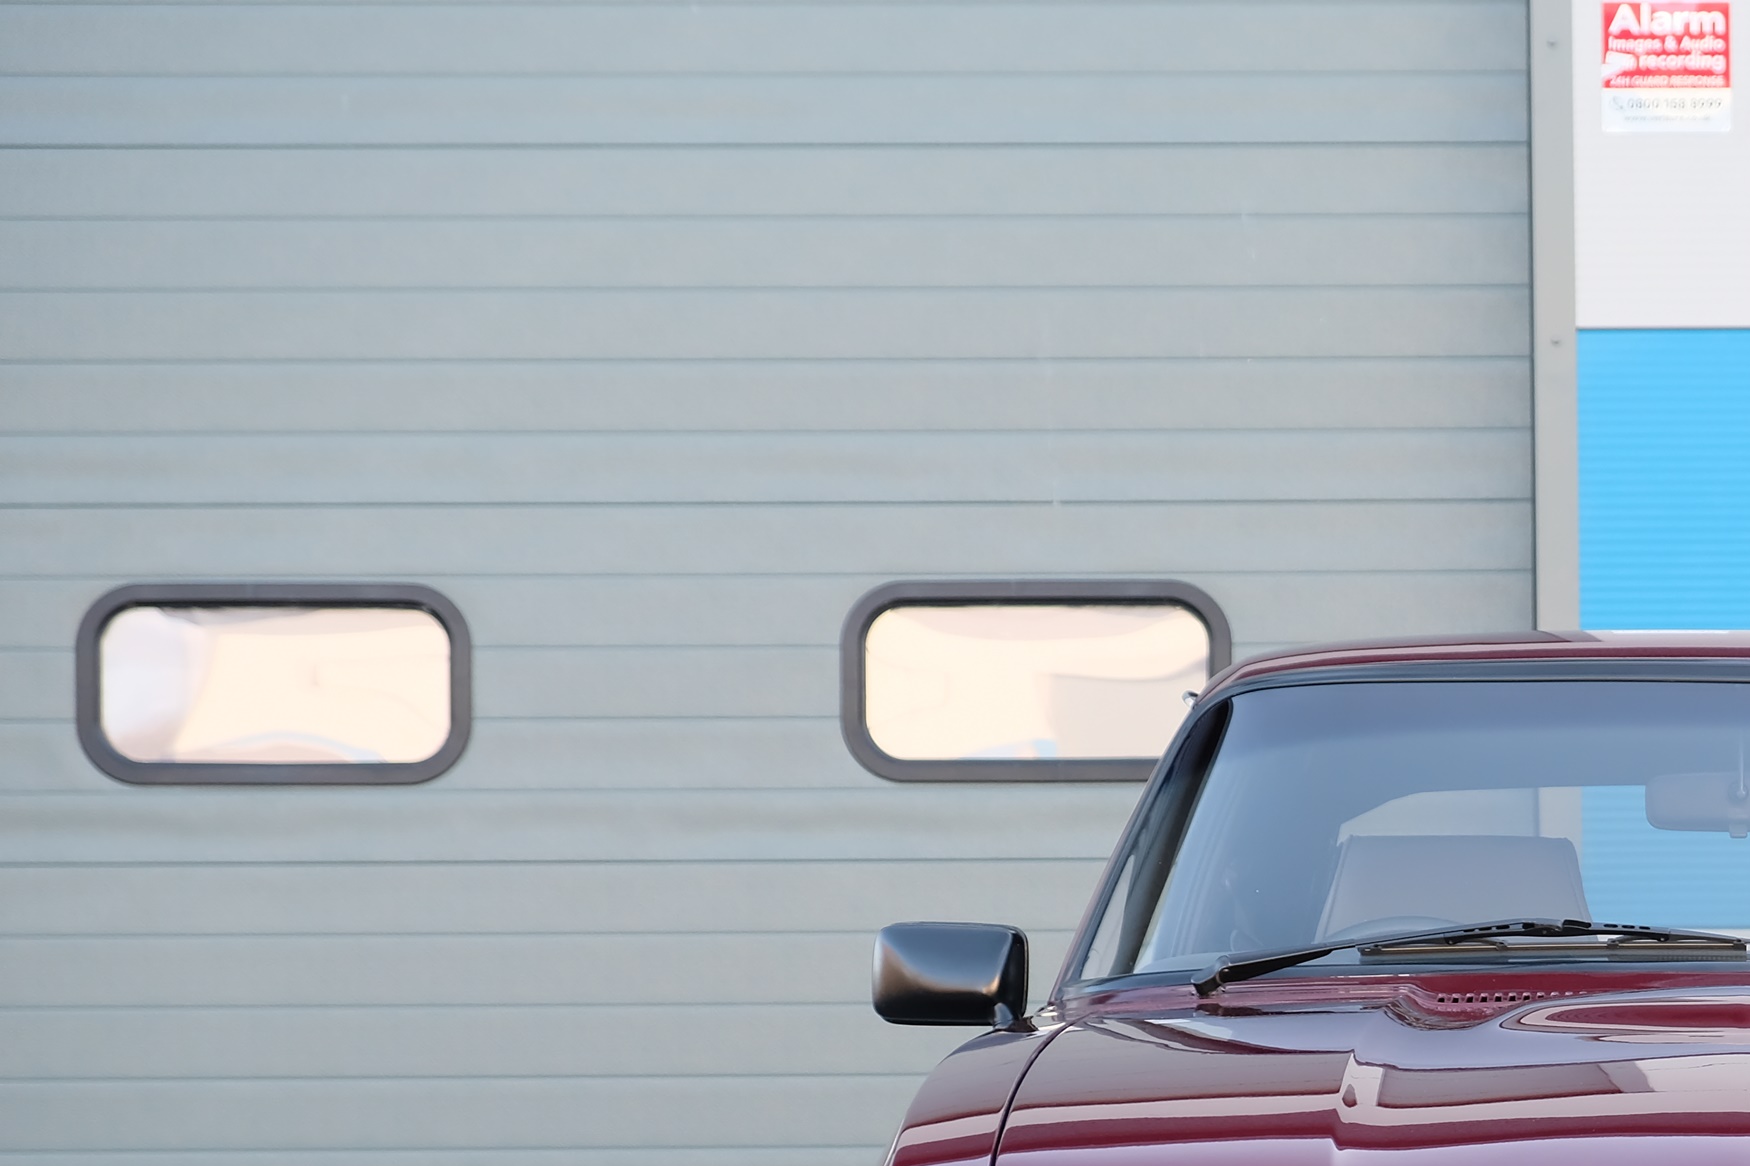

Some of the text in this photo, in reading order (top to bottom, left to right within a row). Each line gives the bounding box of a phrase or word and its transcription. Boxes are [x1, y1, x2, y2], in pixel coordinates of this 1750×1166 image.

[1608, 2, 1726, 35] Alarm
[1609, 35, 1726, 56] Images & Audio
[1639, 51, 1726, 74] recording
[1627, 97, 1659, 109] 0800
